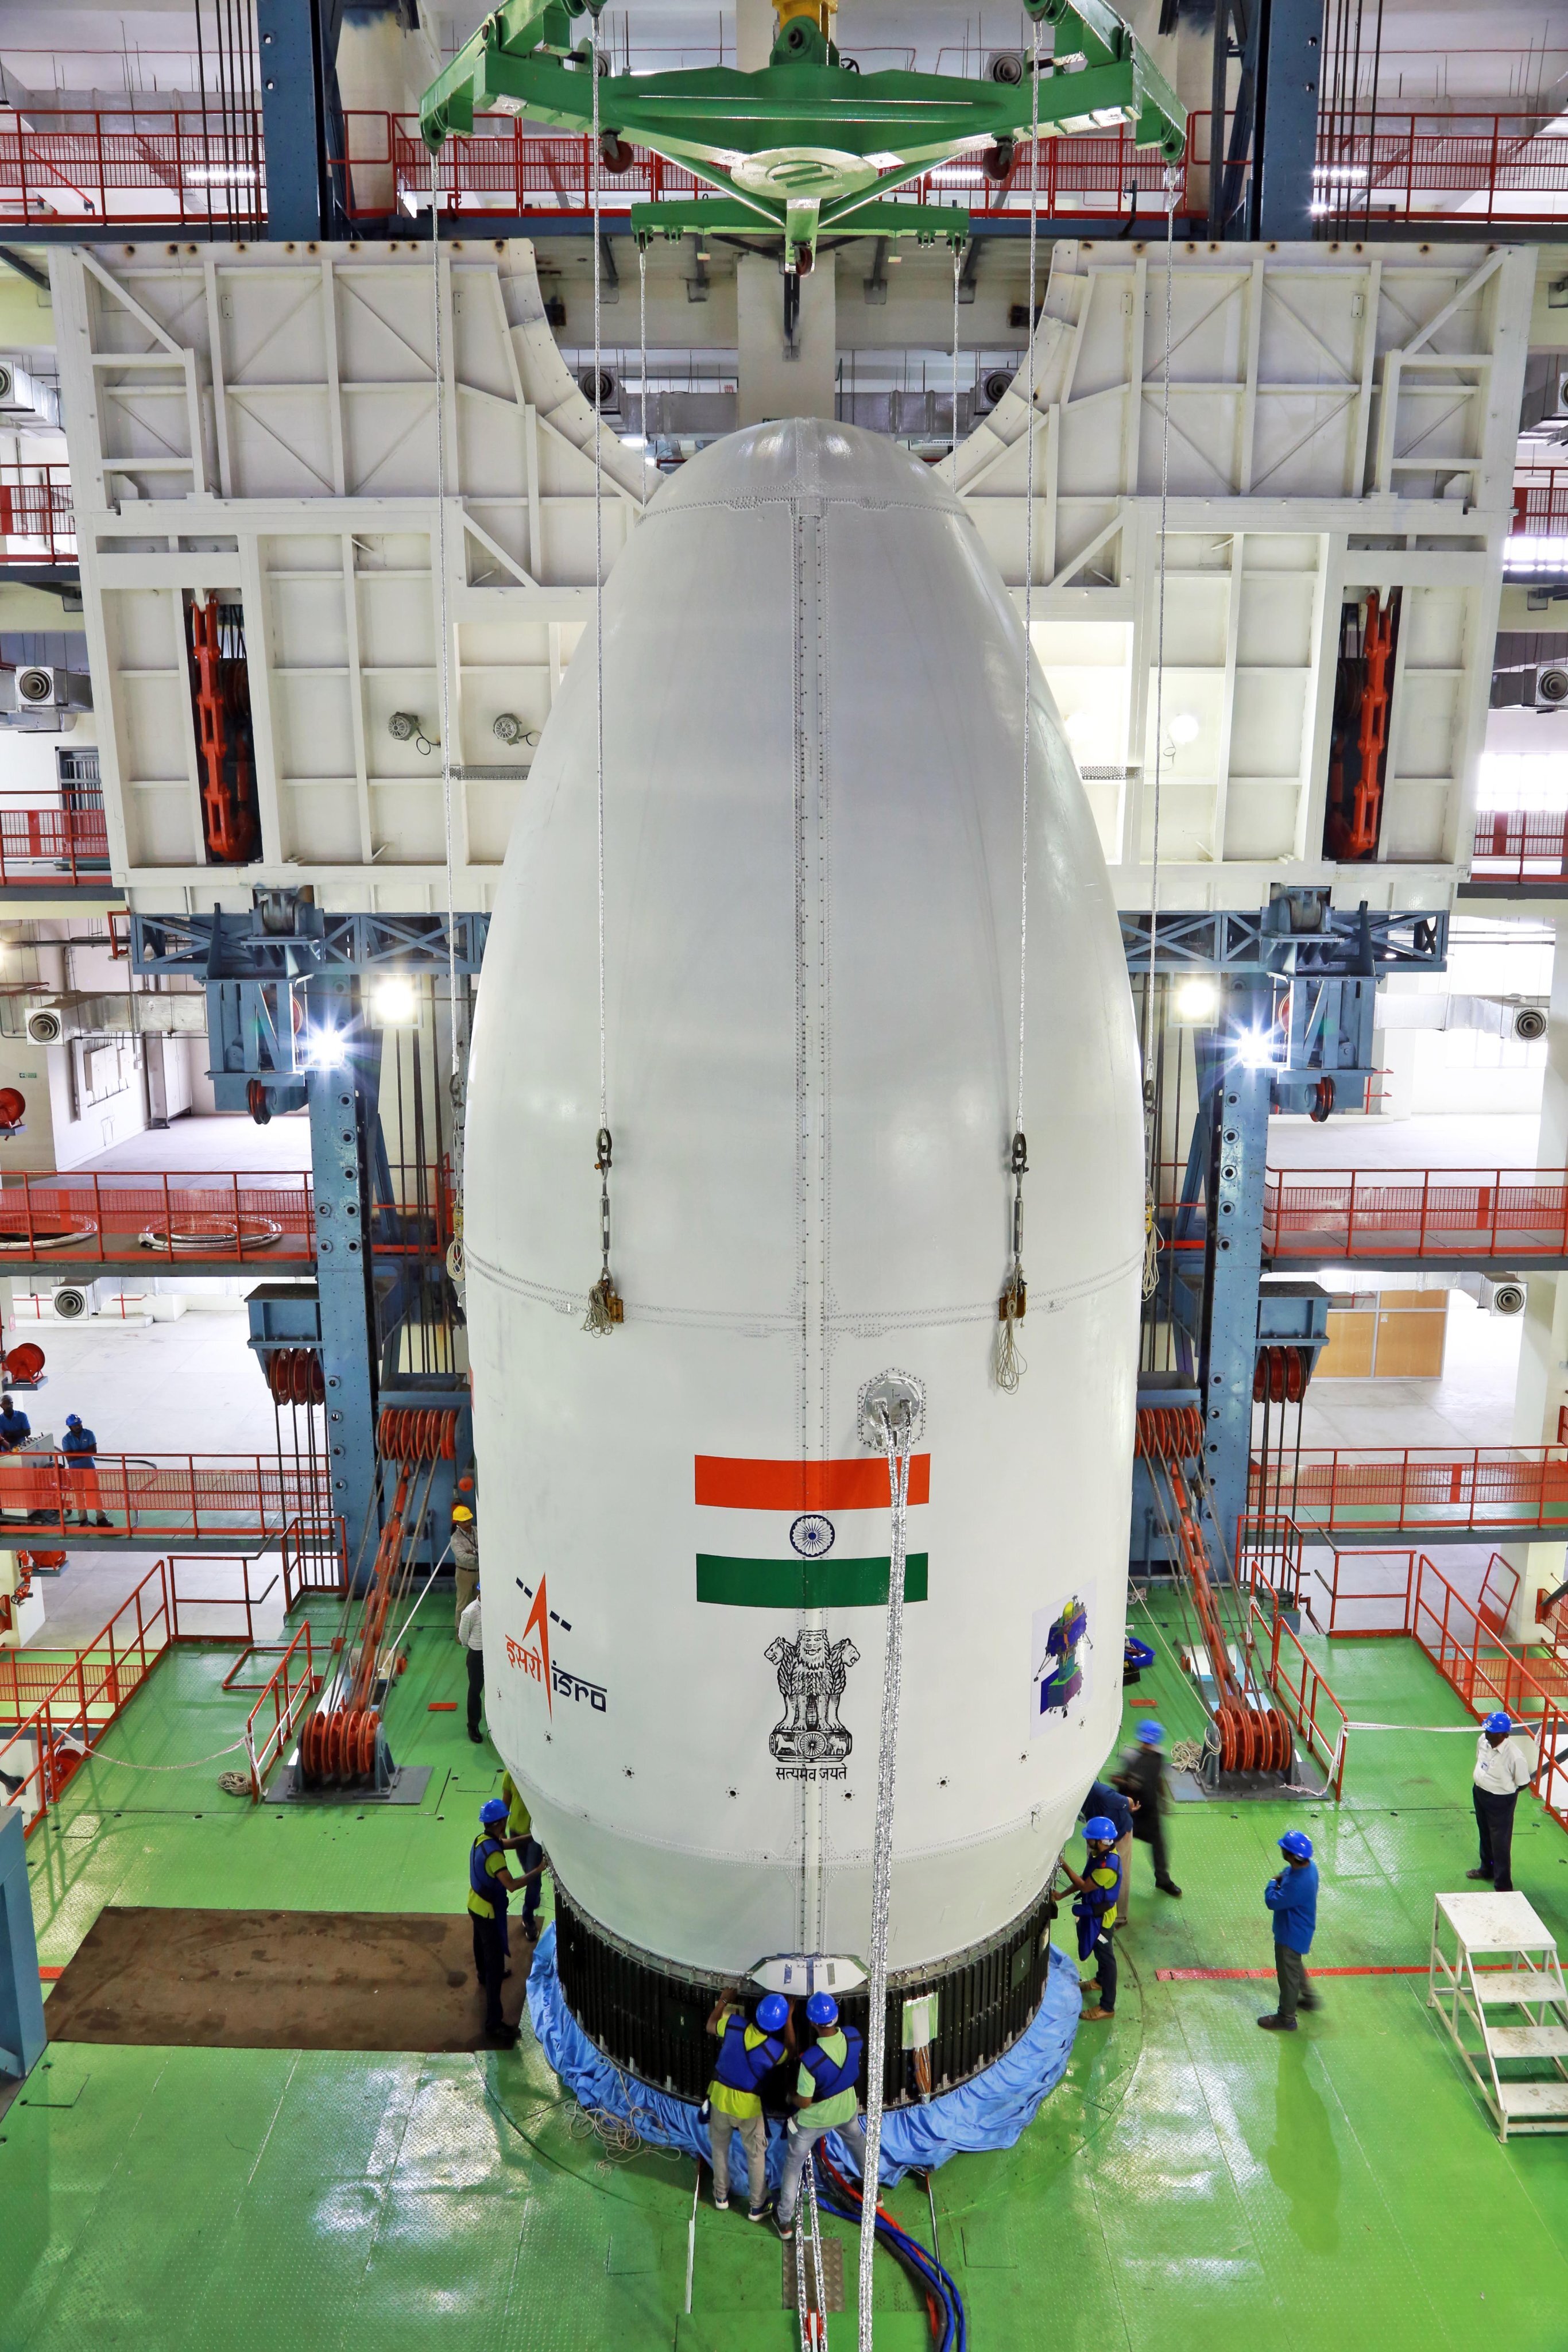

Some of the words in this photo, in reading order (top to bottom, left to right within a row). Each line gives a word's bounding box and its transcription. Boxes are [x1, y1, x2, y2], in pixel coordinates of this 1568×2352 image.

[505, 1634, 541, 1682] इसरो
[551, 1659, 607, 1712] isro
[776, 1763, 817, 1781] सत्यमेव
[819, 1763, 847, 1781] जयते
